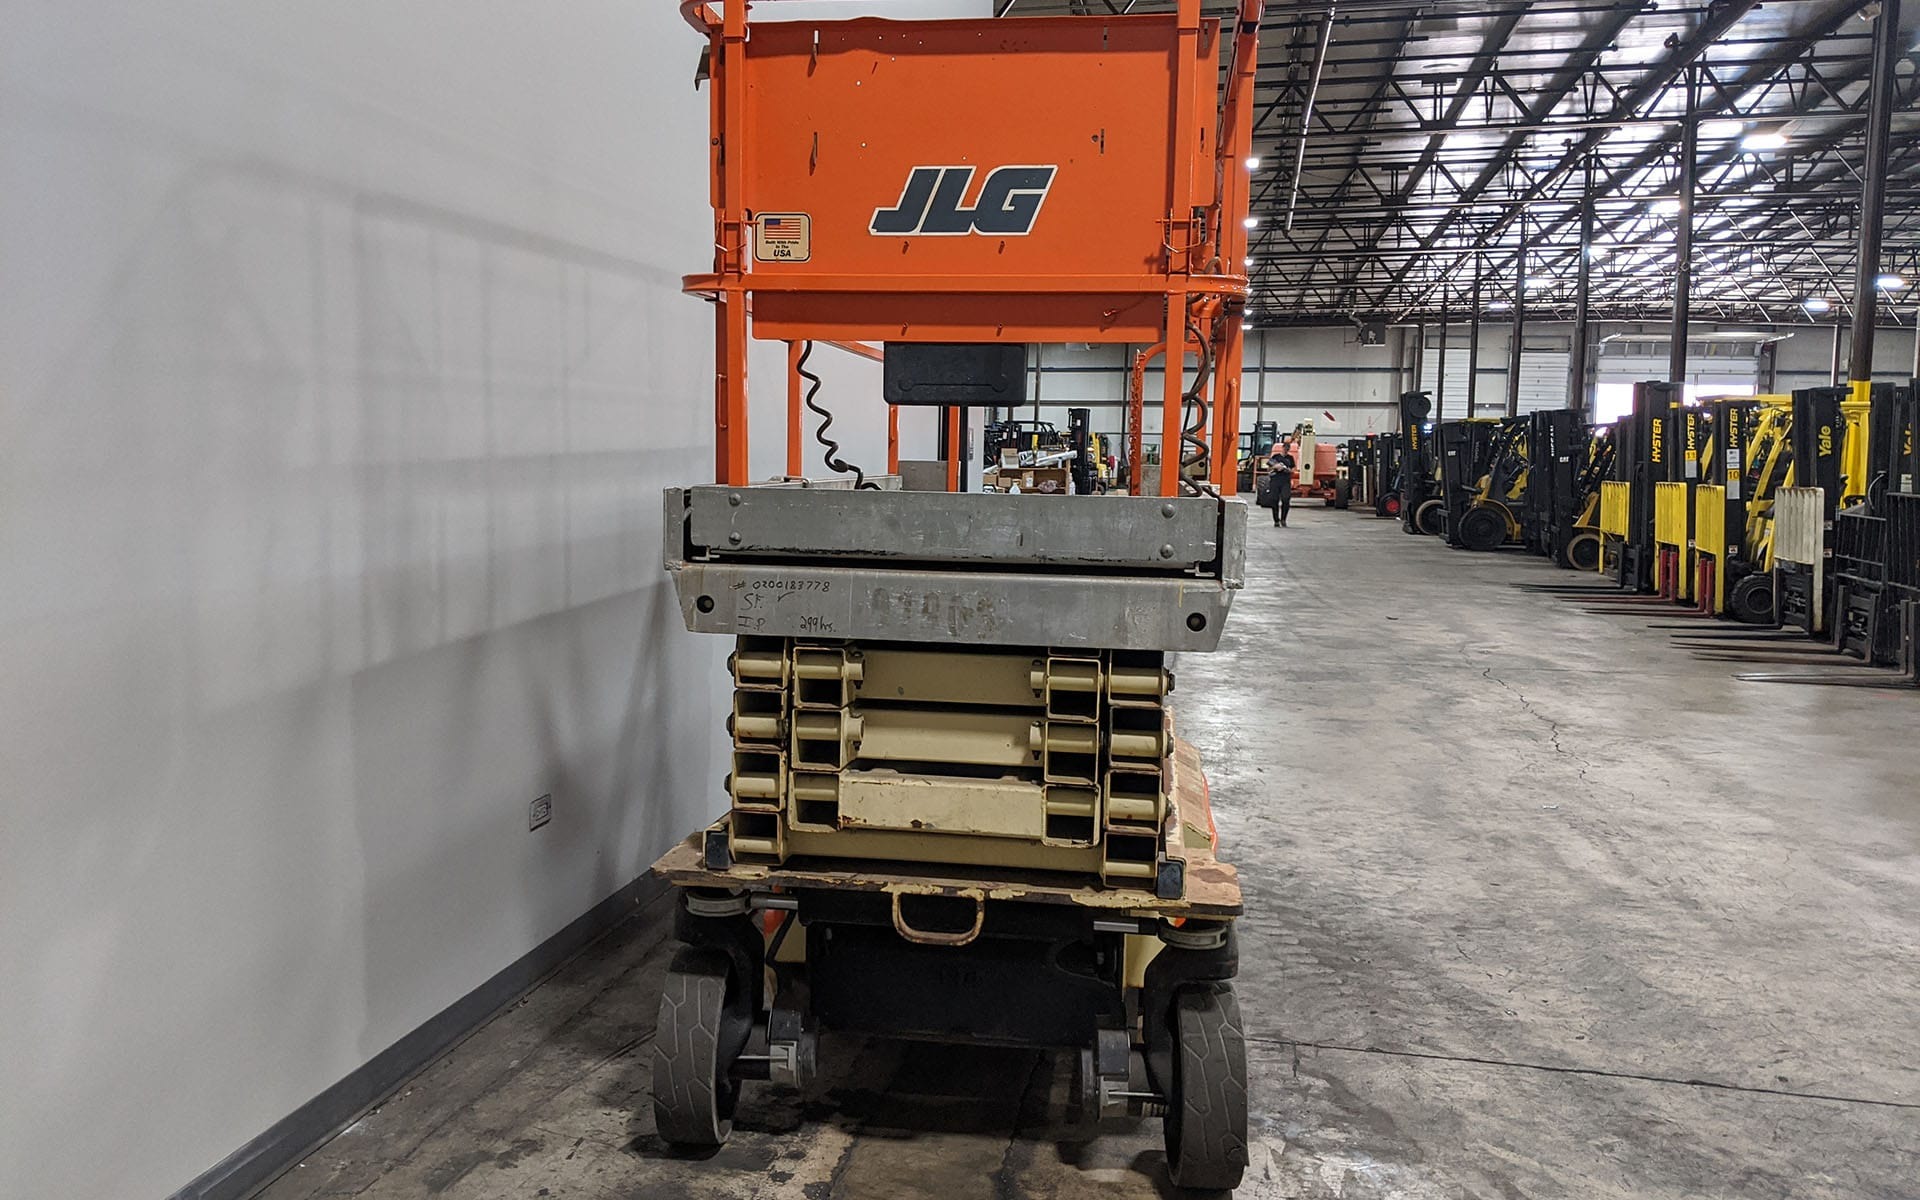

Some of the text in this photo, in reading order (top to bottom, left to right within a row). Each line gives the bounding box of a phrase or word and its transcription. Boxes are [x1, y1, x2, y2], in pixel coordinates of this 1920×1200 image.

[868, 165, 1059, 236] JLG
[773, 249, 792, 257] USA
[1652, 418, 1662, 463] HYSTER
[1687, 413, 1695, 450] HYSTER
[1730, 408, 1738, 448] HYSTER
[1818, 425, 1832, 457] Yale
[1728, 471, 1739, 479] 10
